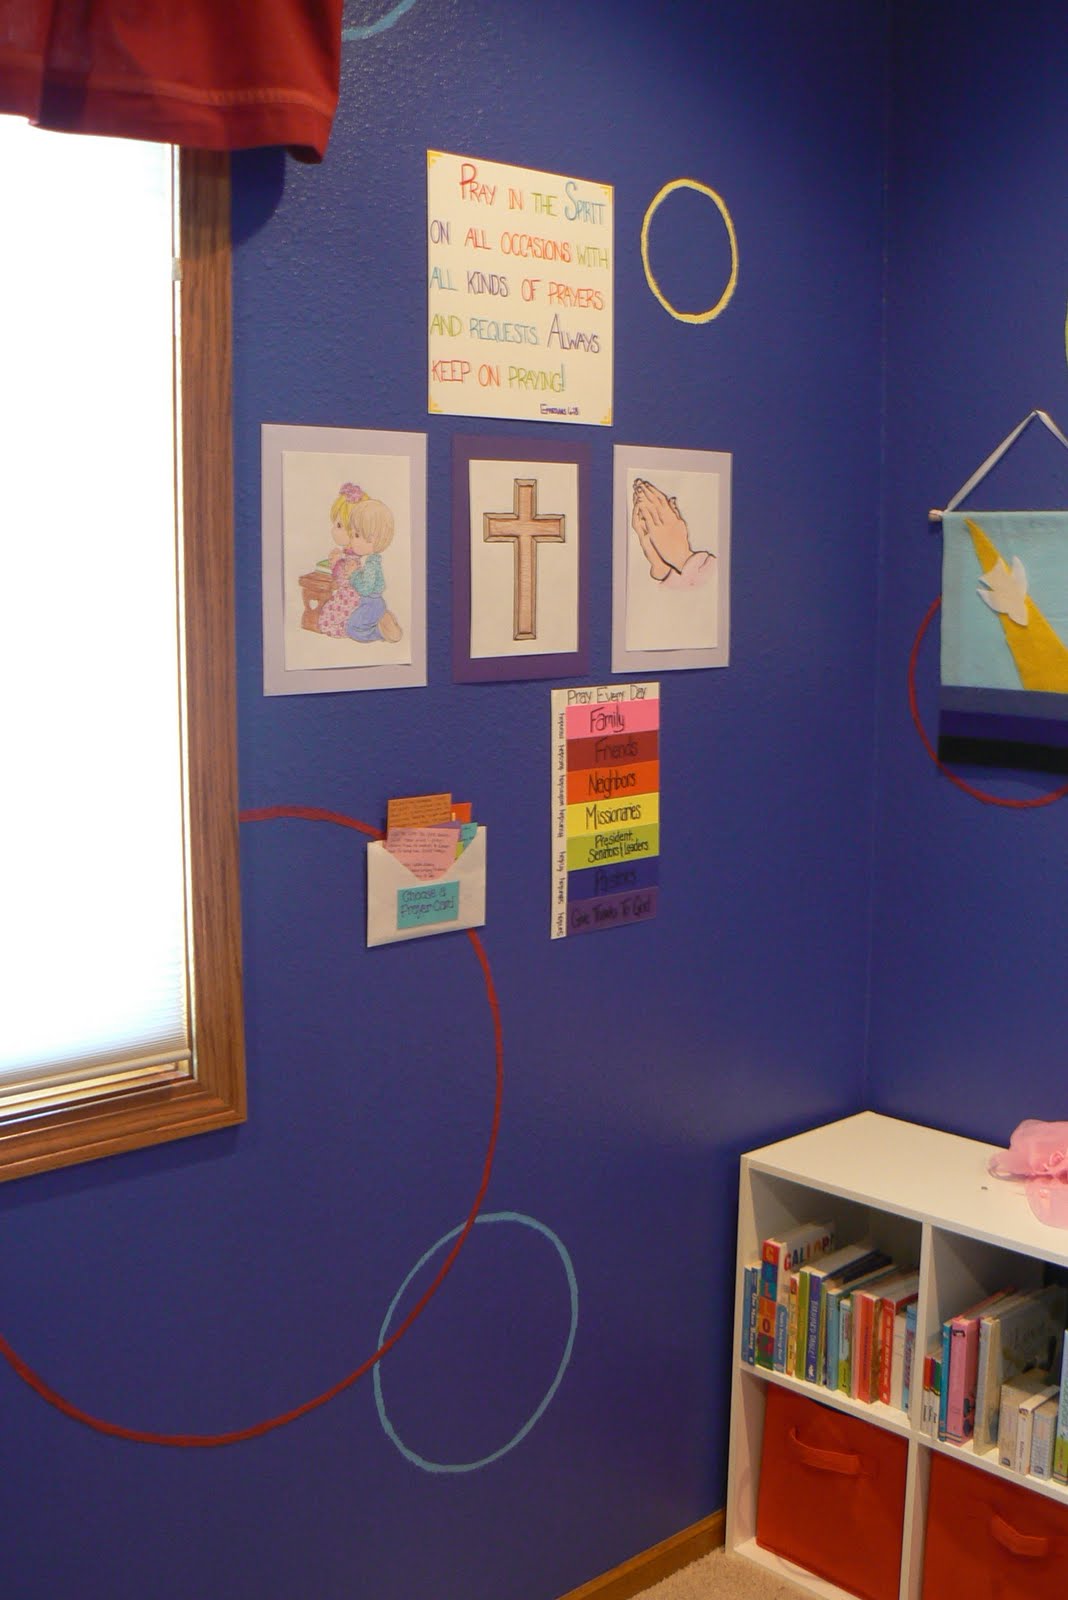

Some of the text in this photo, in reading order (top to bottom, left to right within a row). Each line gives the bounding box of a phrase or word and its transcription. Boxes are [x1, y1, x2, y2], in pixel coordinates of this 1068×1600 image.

[459, 163, 496, 205] PRAY
[508, 188, 523, 210] IN
[531, 192, 558, 217] THE
[430, 219, 608, 268] ON ALL OCCASIONS WITH
[429, 266, 604, 310] ALL KINDS OF PRAYERS
[430, 313, 462, 337] AND
[547, 313, 600, 354] ALWAYS
[431, 360, 565, 392] KEEP ON PRAYING!
[567, 684, 647, 706] Pray Every Day
[590, 705, 625, 733] Family
[588, 769, 636, 799] Neighbors
[586, 804, 642, 830] Missionaries
[402, 888, 436, 903] Choose
